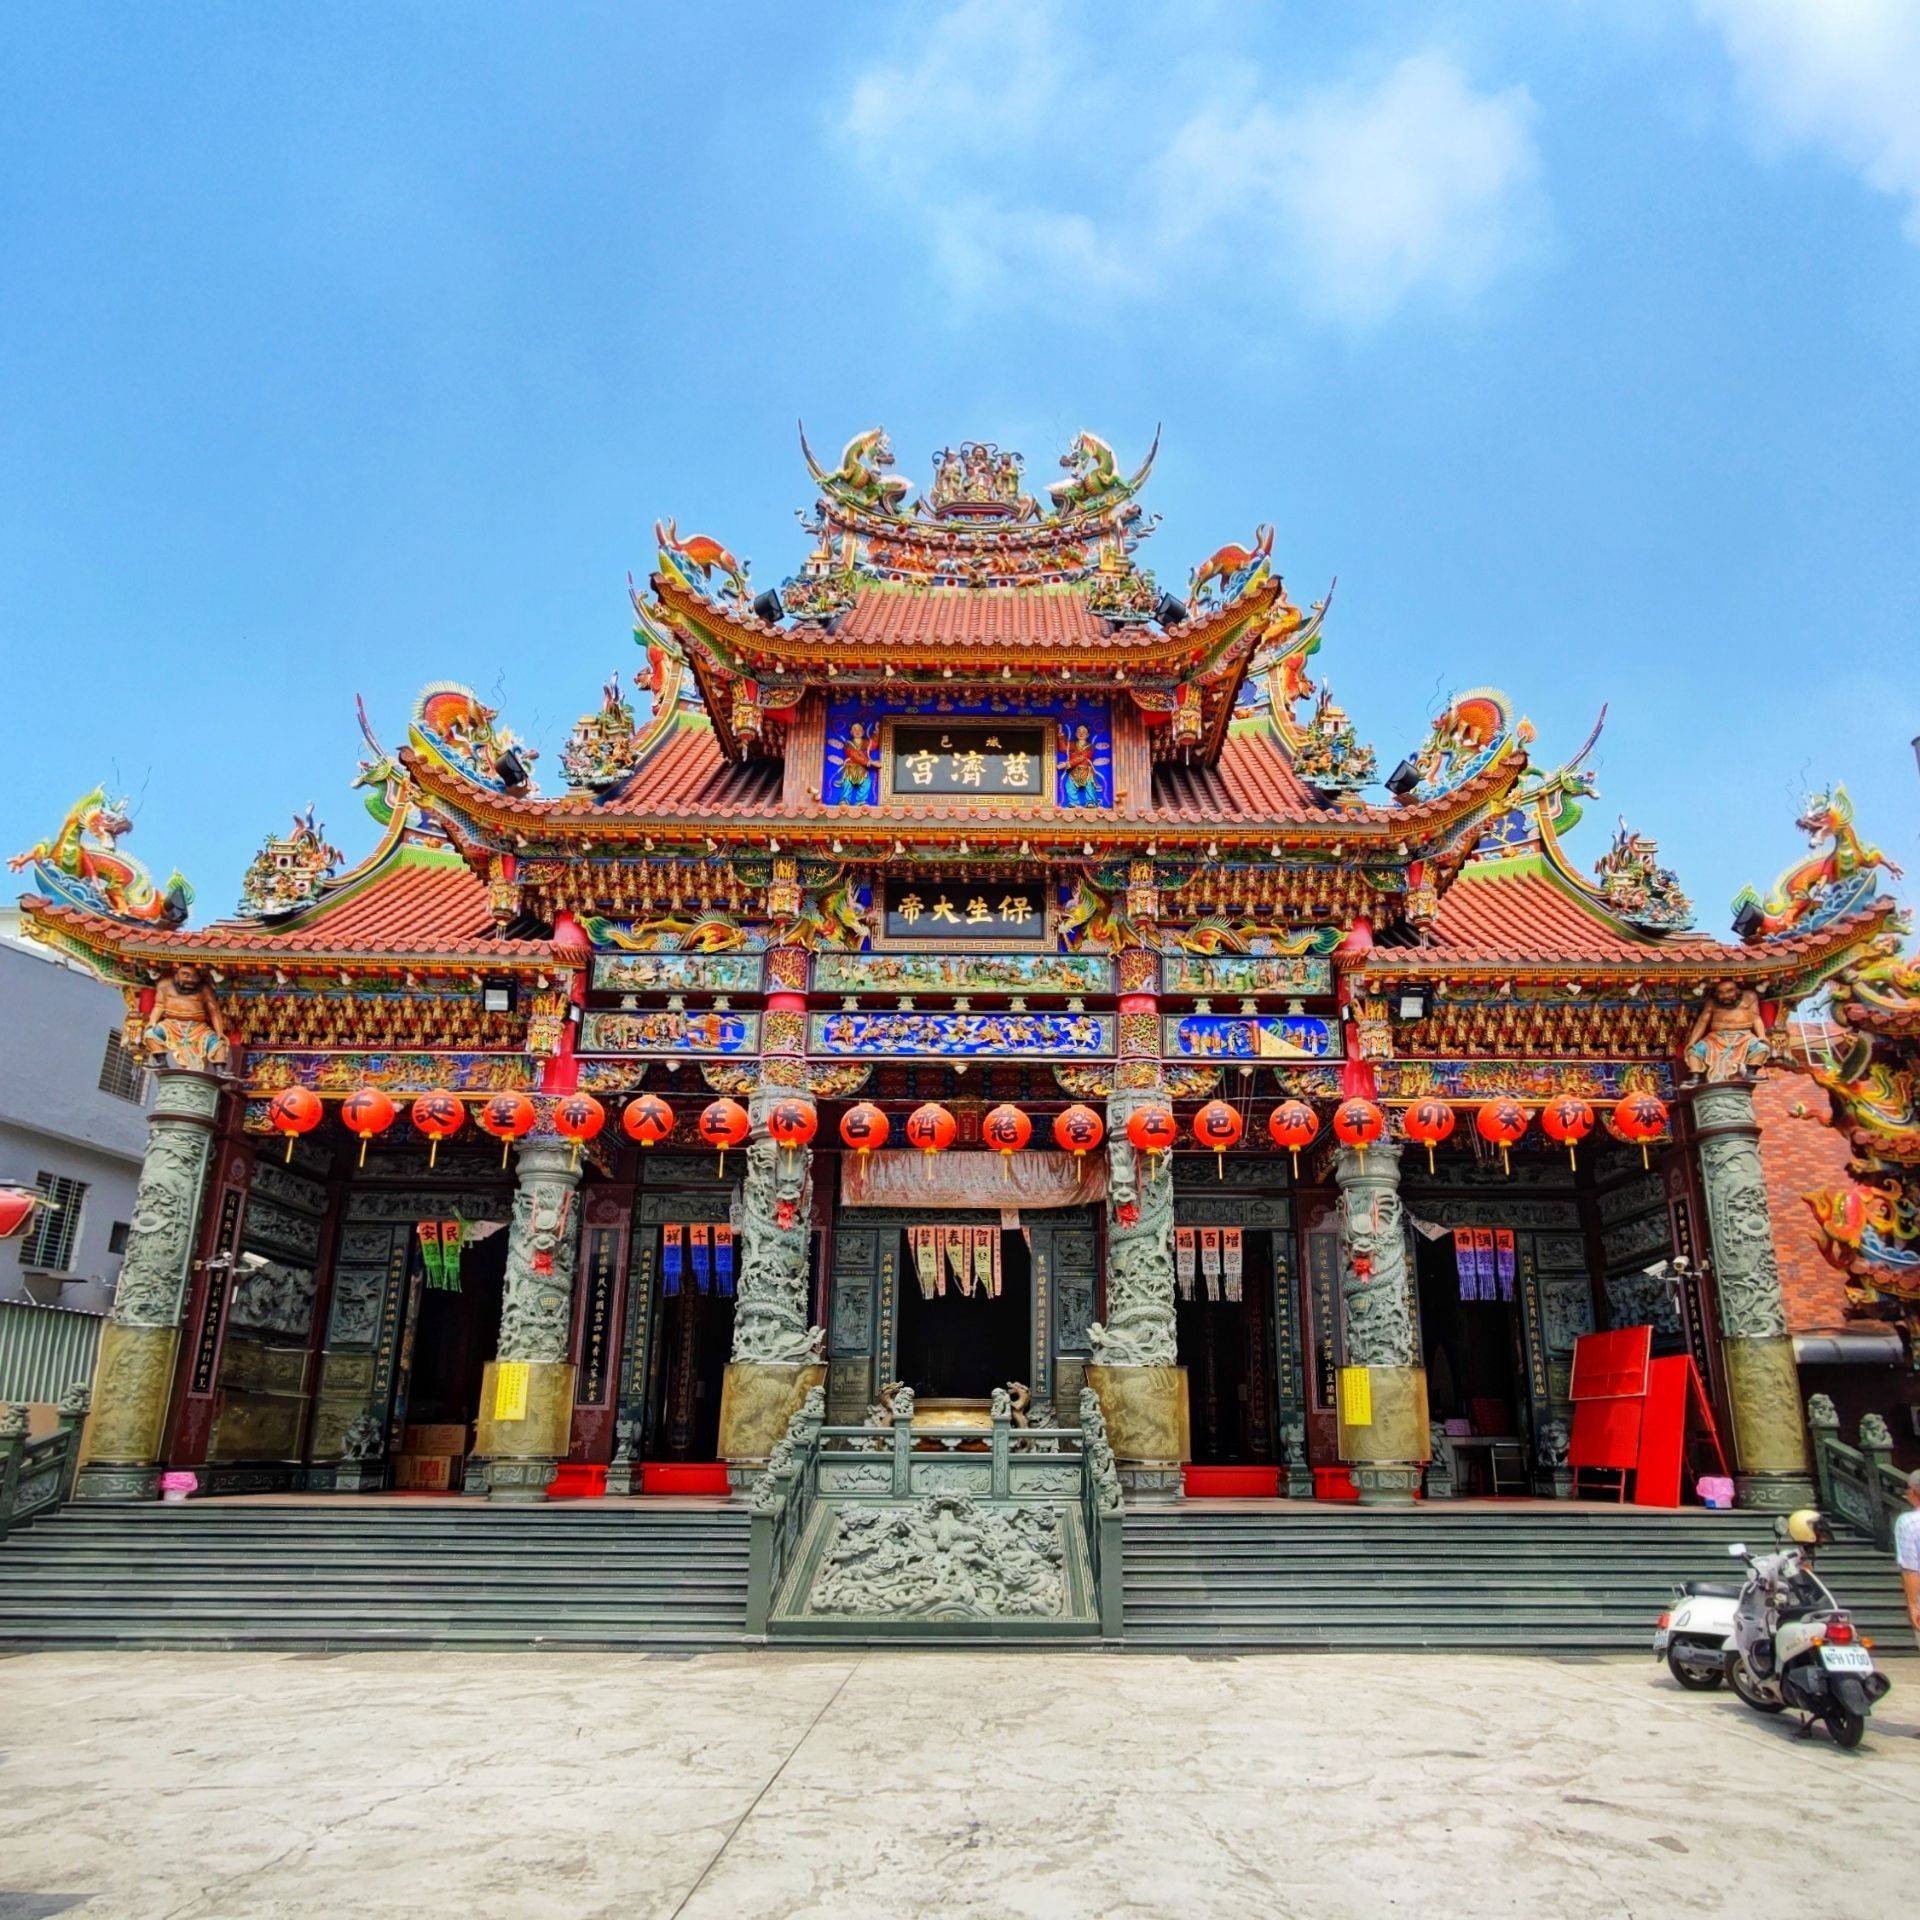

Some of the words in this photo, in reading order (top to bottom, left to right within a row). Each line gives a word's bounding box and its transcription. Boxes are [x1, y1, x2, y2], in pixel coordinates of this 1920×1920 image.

[905, 749, 1031, 787] 慈濟宮
[898, 892, 1033, 925] 保生大帝
[414, 1096, 455, 1126] 誕
[490, 1098, 518, 1127] 聖
[562, 1098, 594, 1129] 帝
[633, 1101, 667, 1132] 大
[773, 1105, 807, 1132] 保
[846, 1109, 876, 1138] 宮
[911, 1109, 944, 1142] 濟
[1142, 1108, 1170, 1135] 左
[1206, 1107, 1235, 1137] 邑
[1275, 1106, 1315, 1135] 城
[1343, 1104, 1374, 1136] 年
[1417, 1102, 1450, 1129] 卯
[1495, 1103, 1527, 1132] 癸
[1555, 1100, 1593, 1129] 祝
[1630, 1097, 1666, 1128] 恭
[991, 1111, 1018, 1143] 慈
[1066, 1111, 1097, 1143] 營
